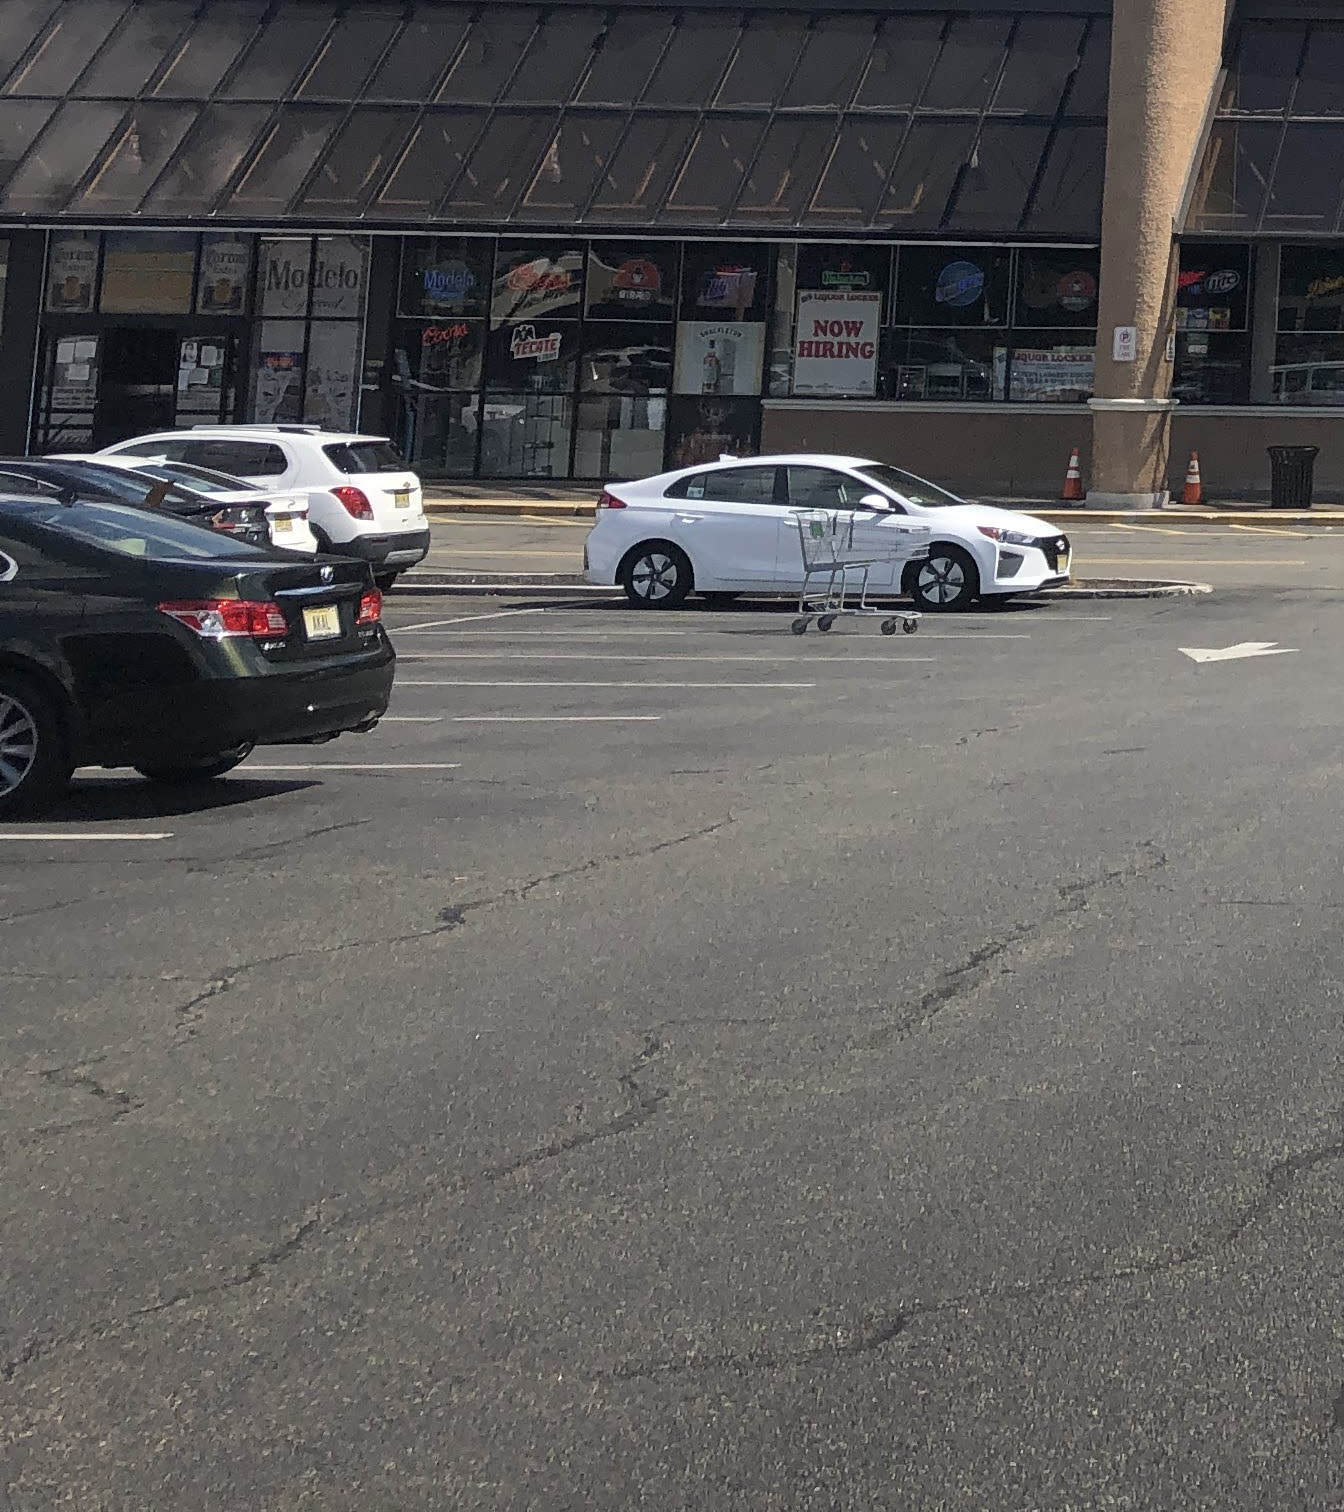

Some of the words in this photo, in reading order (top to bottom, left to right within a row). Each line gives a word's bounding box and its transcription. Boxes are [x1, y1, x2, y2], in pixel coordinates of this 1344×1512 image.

[812, 319, 864, 338] NOW
[515, 338, 559, 356] TECATE
[798, 341, 875, 359] HIRING
